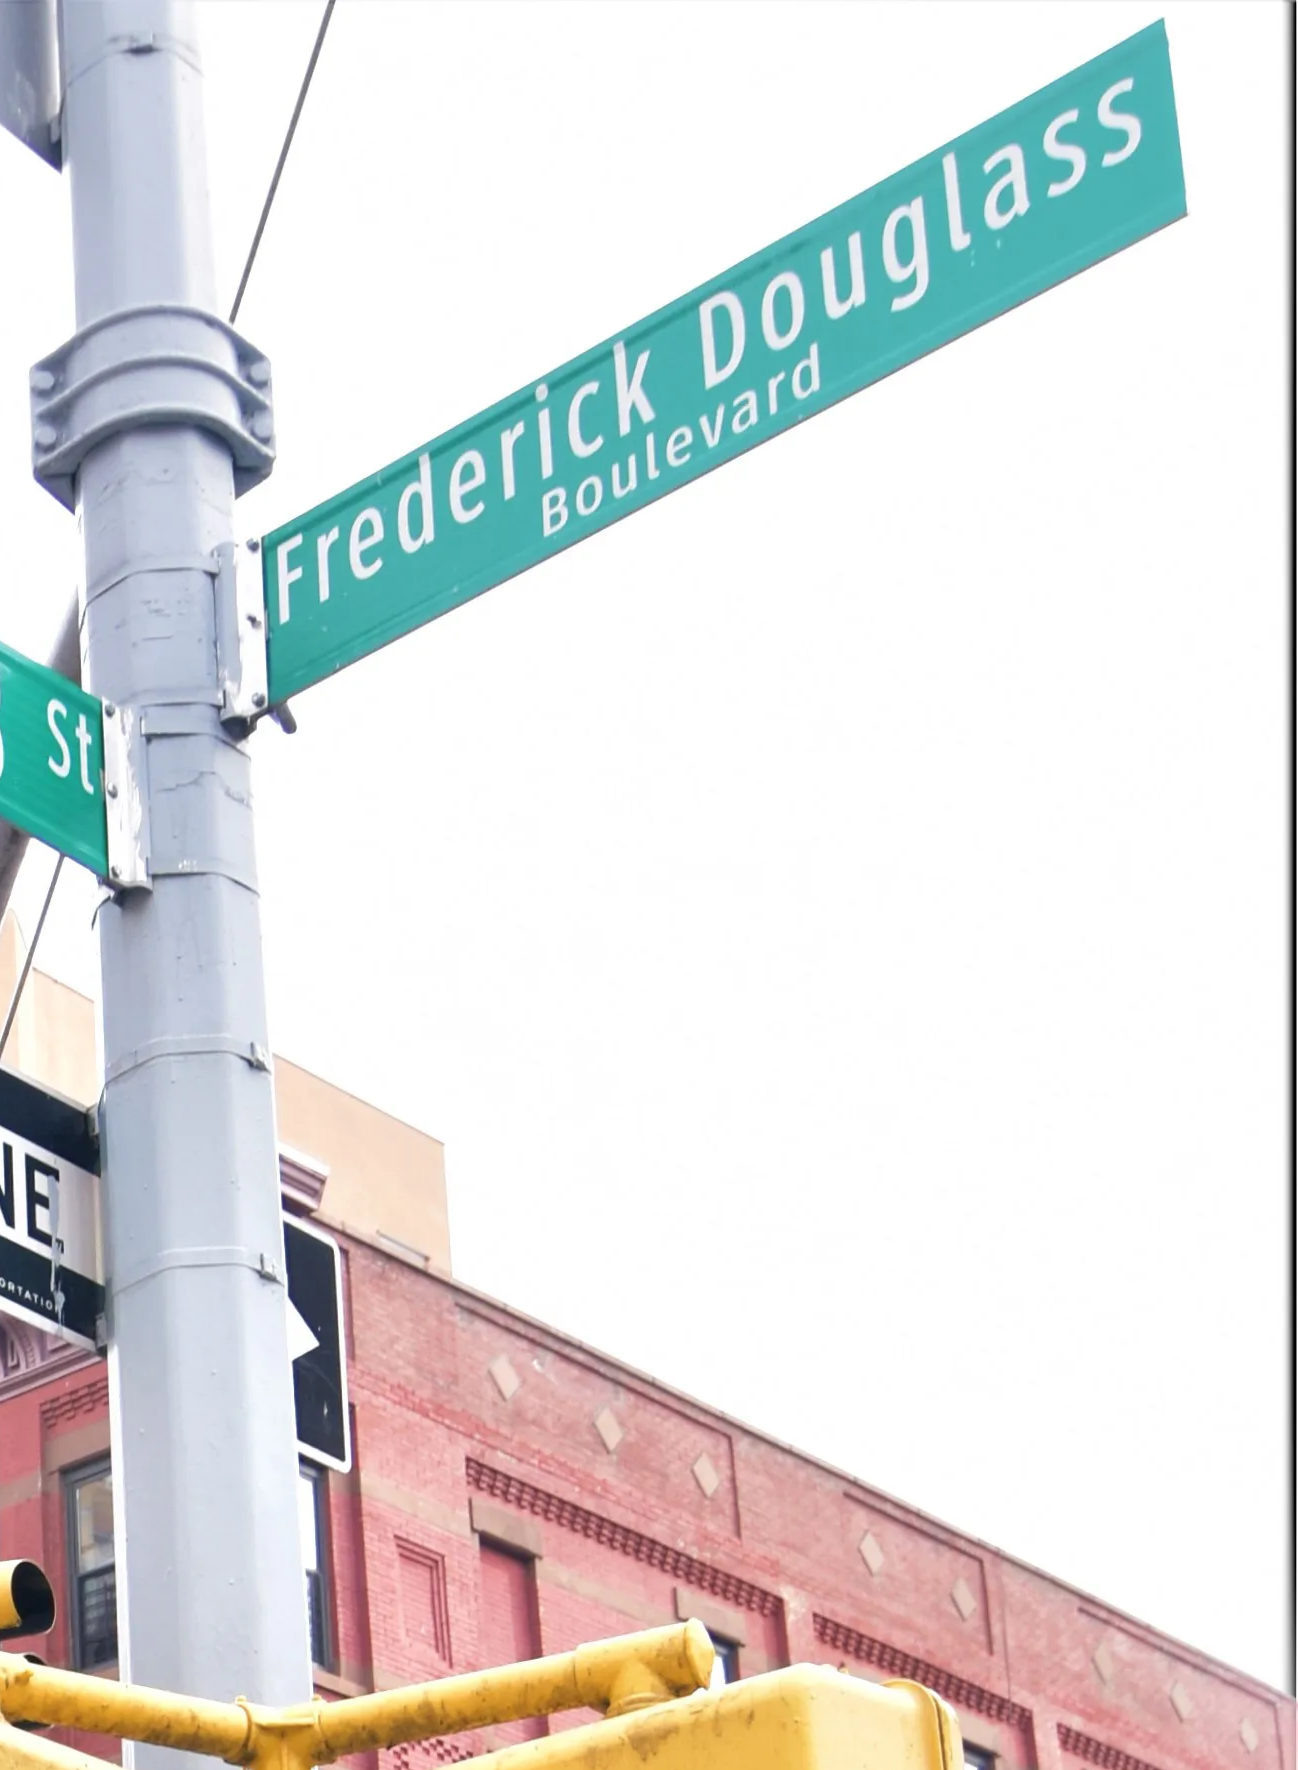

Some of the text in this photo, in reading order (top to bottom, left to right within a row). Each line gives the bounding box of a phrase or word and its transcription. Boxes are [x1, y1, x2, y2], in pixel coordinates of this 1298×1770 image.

[276, 76, 1144, 626] Frederick Douglass
[542, 343, 822, 538] Boulevard
[46, 697, 96, 797] St
